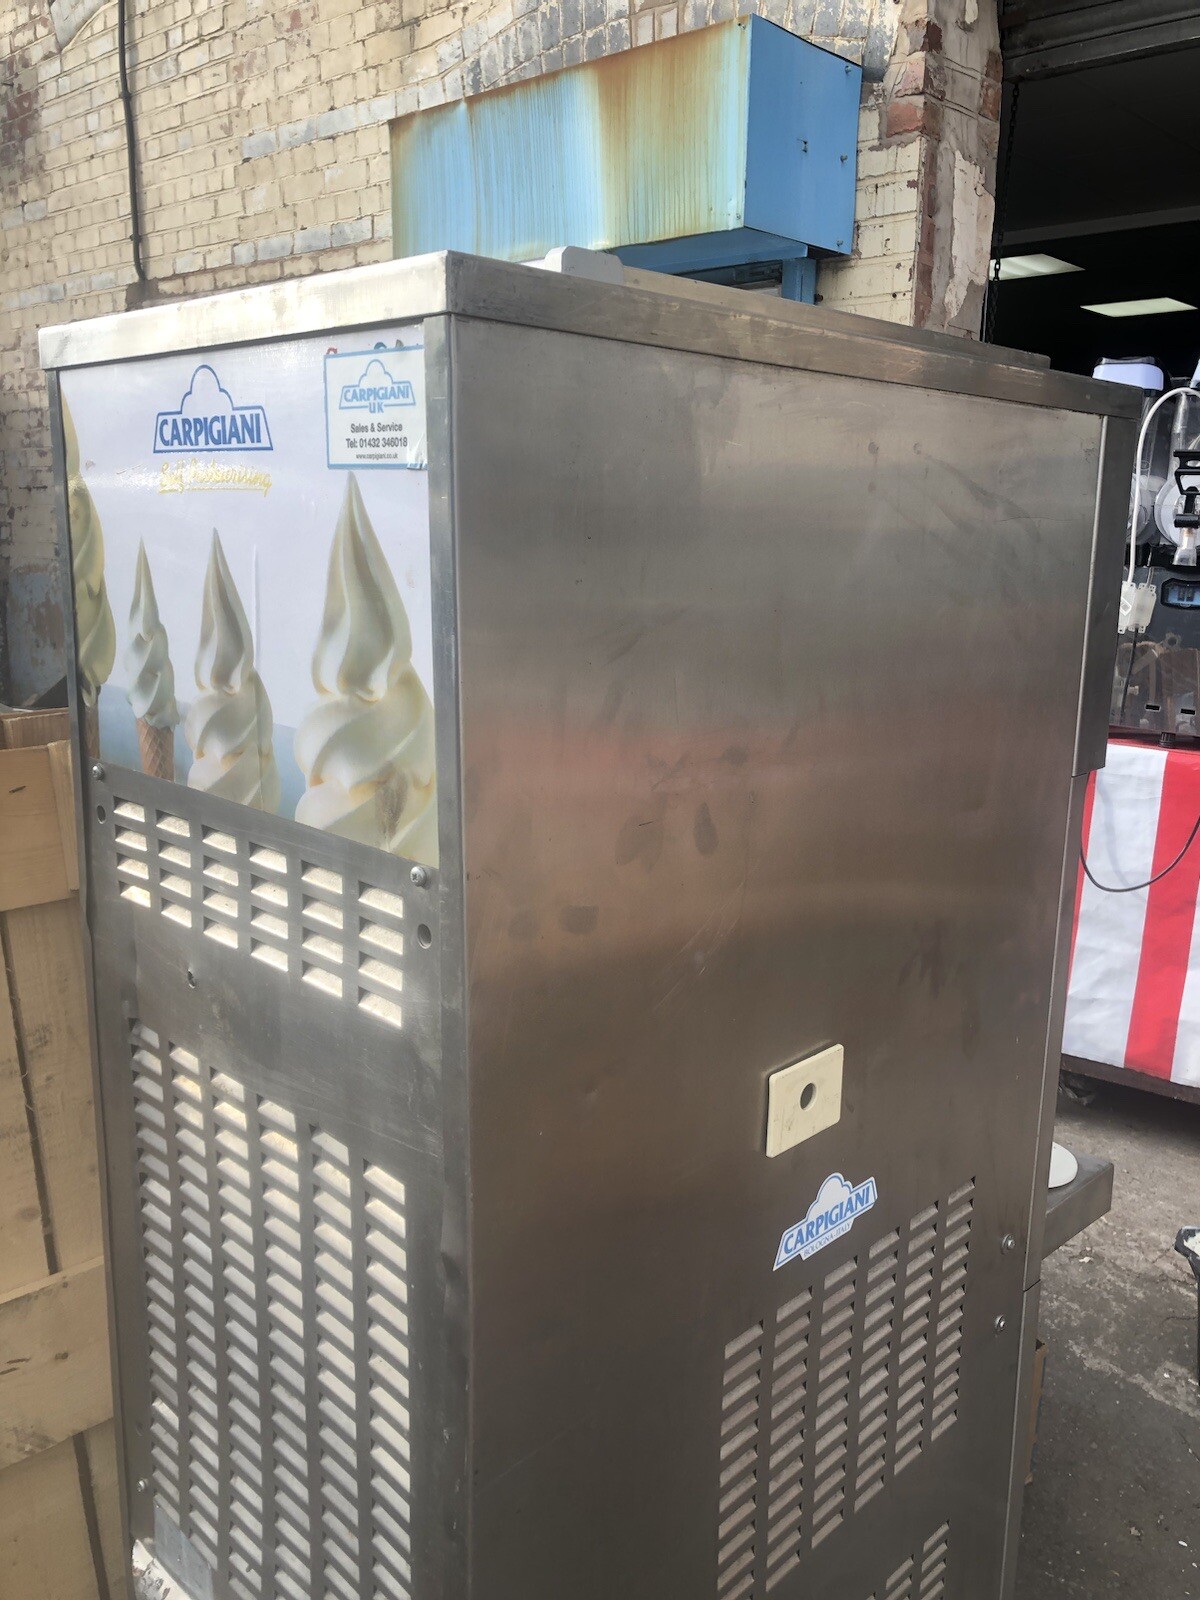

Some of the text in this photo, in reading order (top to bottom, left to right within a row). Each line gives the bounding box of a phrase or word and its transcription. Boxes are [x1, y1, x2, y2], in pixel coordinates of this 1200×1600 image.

[344, 386, 409, 402] CARPIGIANI
[369, 402, 384, 413] UK
[159, 413, 261, 446] CARPIGIANI
[350, 422, 403, 433] Sales & Service
[346, 436, 407, 449] Tel: 01432 346018
[784, 1186, 870, 1254] CARPIGIANI
